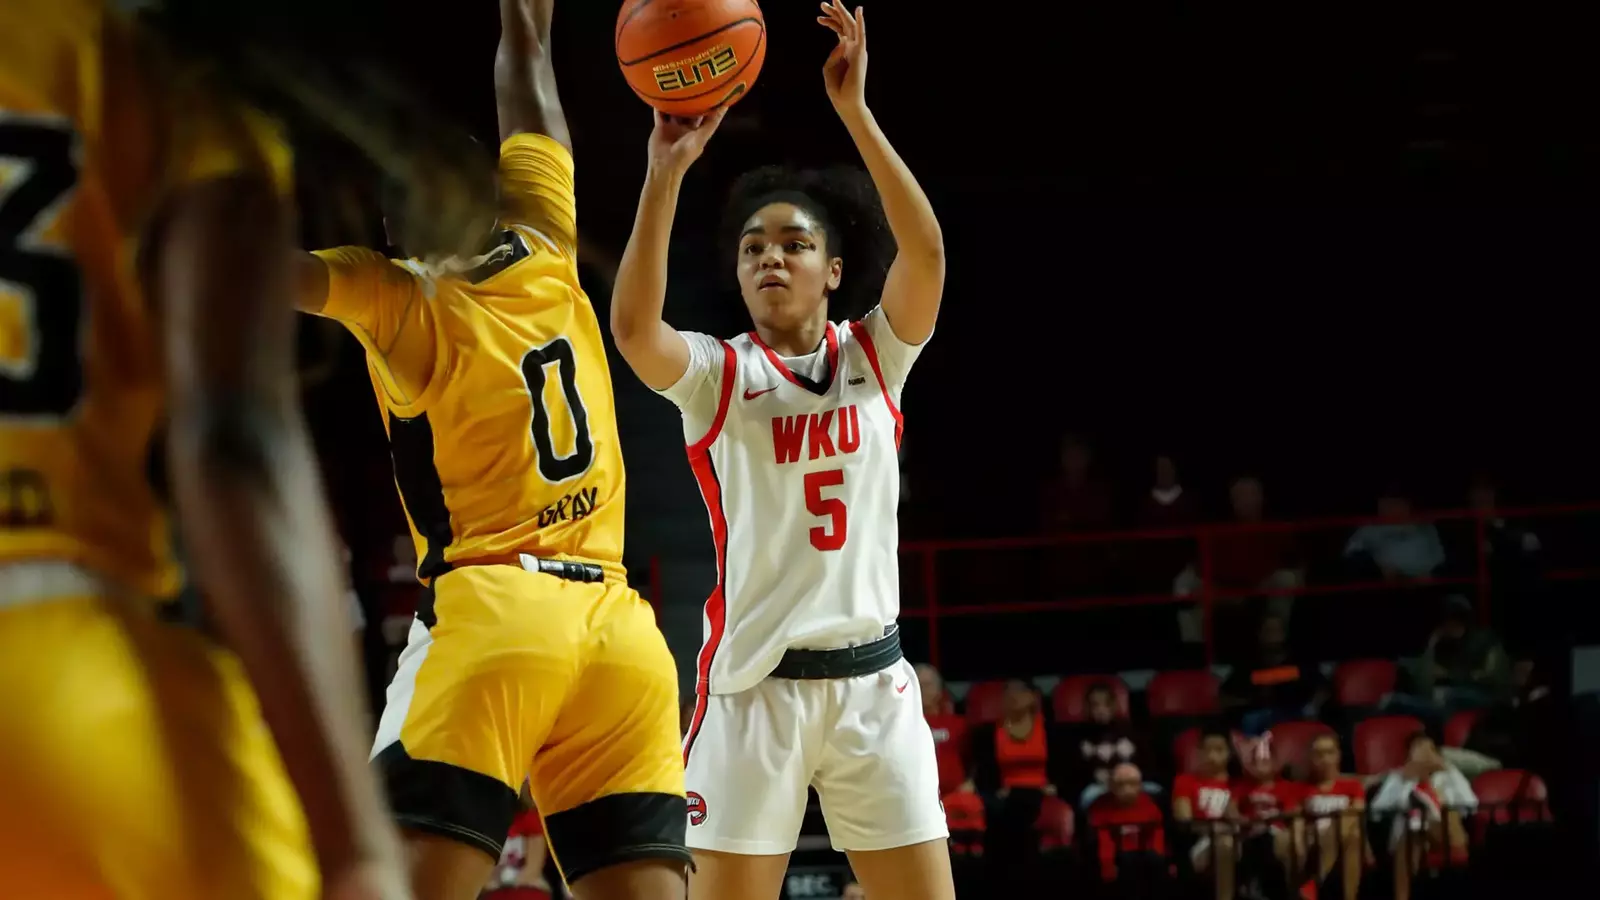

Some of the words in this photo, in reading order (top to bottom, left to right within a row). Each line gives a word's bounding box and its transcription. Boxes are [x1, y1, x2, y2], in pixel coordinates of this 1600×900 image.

[654, 46, 738, 92] ELITE
[521, 335, 594, 484] 0
[772, 405, 861, 464] WKU
[537, 487, 598, 528] GRAY
[804, 469, 847, 551] 5
